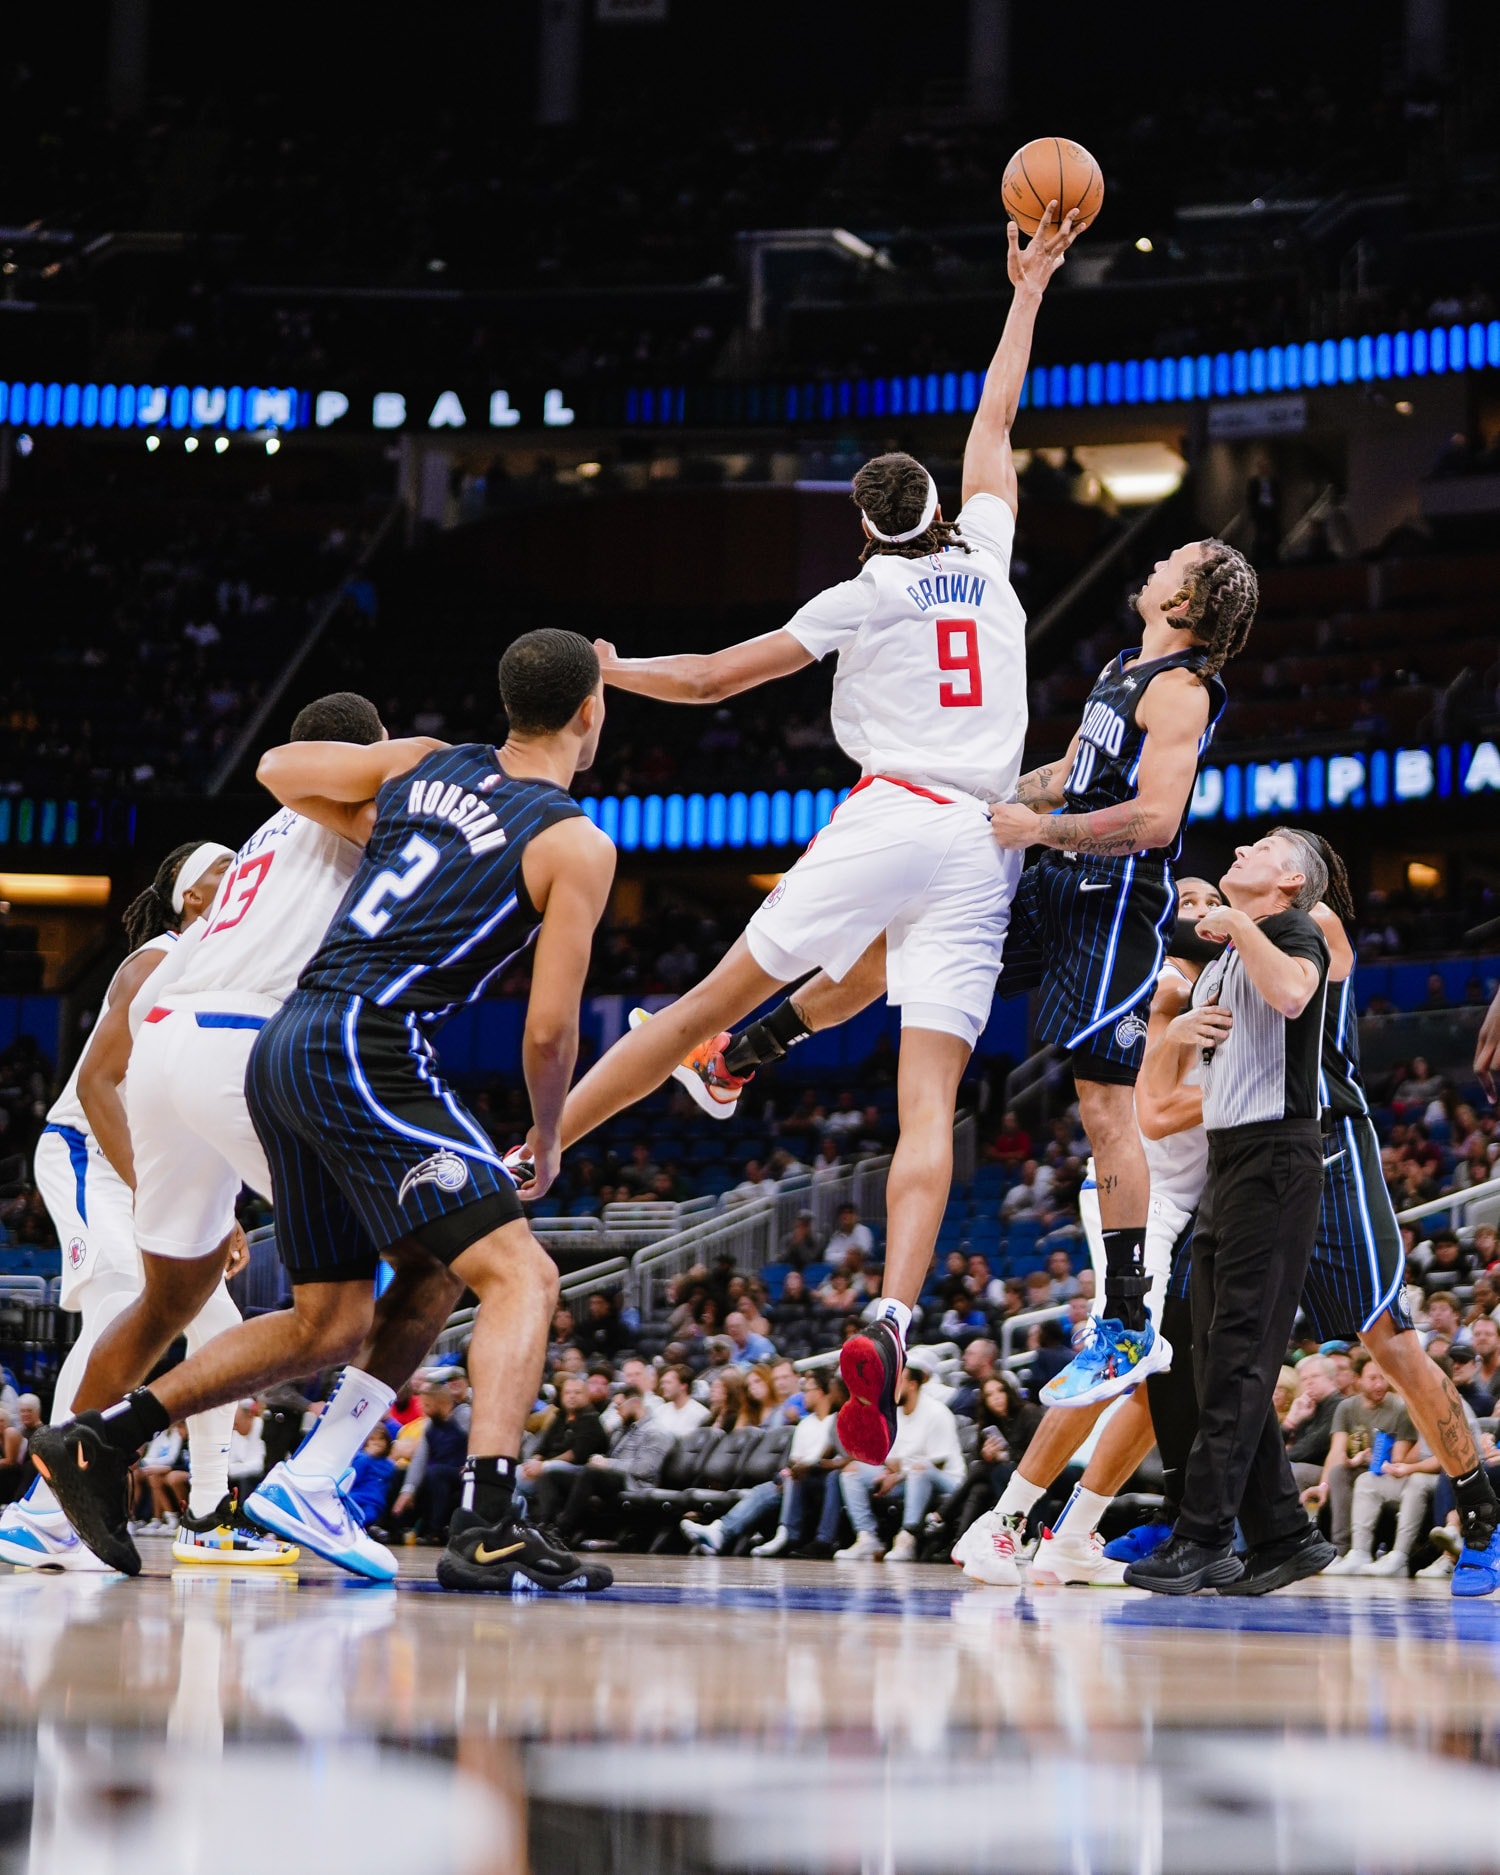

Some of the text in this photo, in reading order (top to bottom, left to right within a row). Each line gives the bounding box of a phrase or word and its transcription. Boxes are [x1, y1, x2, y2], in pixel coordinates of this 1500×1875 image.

[906, 573, 986, 612] BROWN
[936, 618, 982, 707] 9
[407, 779, 507, 855] HOUSTAN
[1077, 837, 1136, 856] Gregory
[348, 831, 441, 939] 2
